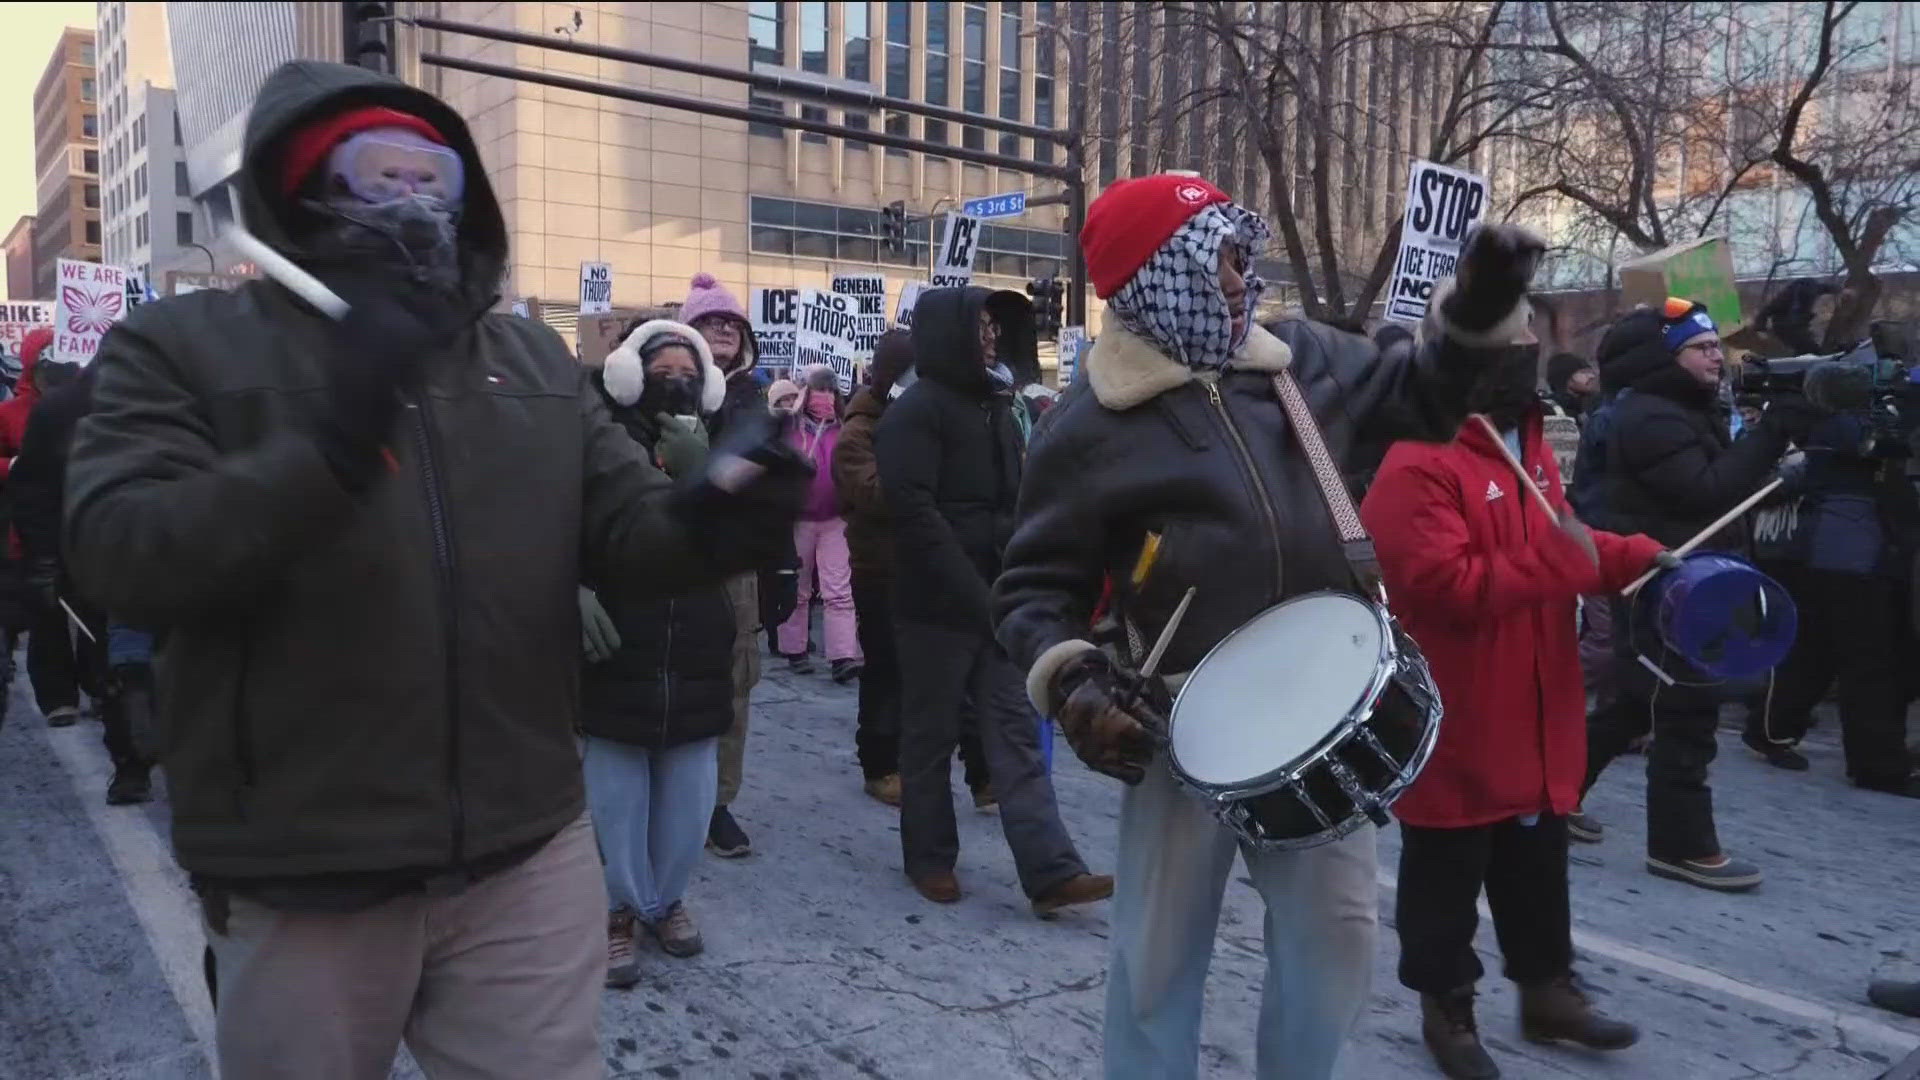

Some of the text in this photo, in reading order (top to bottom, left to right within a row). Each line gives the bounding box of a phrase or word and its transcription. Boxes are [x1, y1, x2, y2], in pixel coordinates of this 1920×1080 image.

[976, 197, 1023, 214] S 3rd St
[1413, 168, 1483, 241] STOP
[945, 216, 977, 267] ICE
[1403, 245, 1457, 279] ICE TERR
[62, 263, 123, 286] WE ARE
[590, 267, 608, 279] NO
[933, 275, 957, 286] OUT
[583, 279, 612, 302] TROOPS
[833, 278, 884, 294] GENERAL
[762, 289, 797, 324] ICE
[816, 293, 846, 311] NO
[802, 303, 856, 342] TROOPS
[875, 318, 884, 331] TO
[820, 341, 834, 353] IN
[1062, 343, 1075, 353] WA
[797, 346, 851, 376] MINNESOTA
